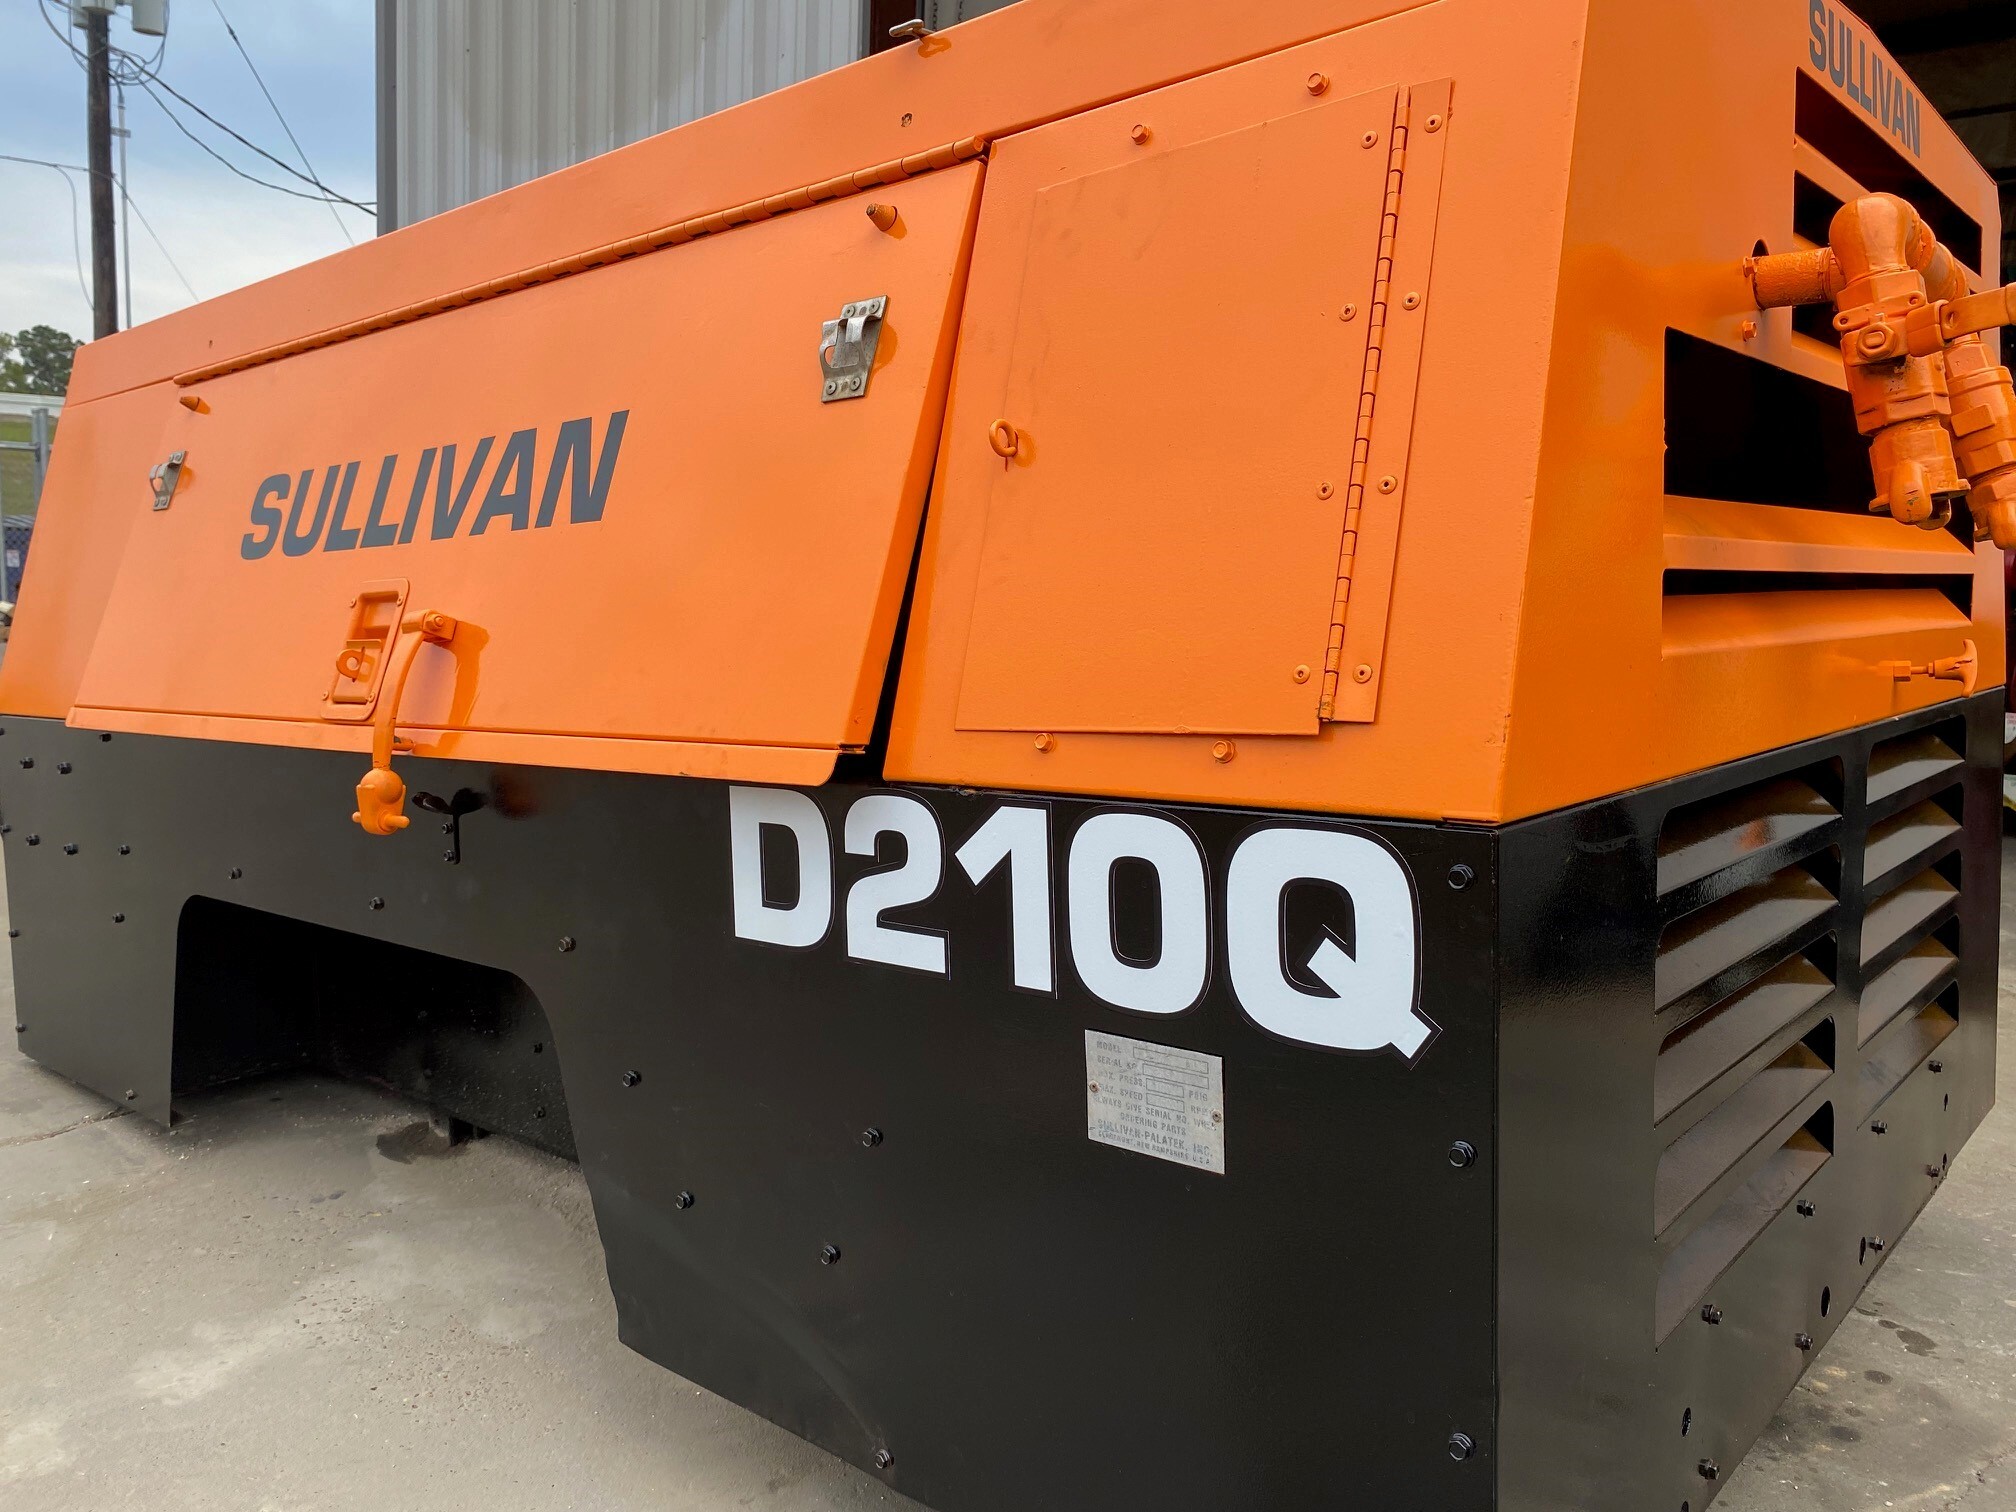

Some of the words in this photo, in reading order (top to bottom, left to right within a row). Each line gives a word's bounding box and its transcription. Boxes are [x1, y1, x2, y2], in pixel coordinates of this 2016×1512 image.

[1809, 0, 1920, 159] SULLIVAN
[241, 410, 629, 560] SULLIVAN
[729, 785, 1436, 1060] D210Q
[1096, 1041, 1122, 1054] MODEL
[1097, 1055, 1123, 1068] SERIAL
[1098, 1070, 1116, 1081] AX.
[1120, 1089, 1143, 1101] SPEED
[1126, 1103, 1142, 1114] GIVE
[1145, 1106, 1172, 1121] SERIAL
[1120, 1112, 1158, 1129] ORDERING
[1161, 1122, 1187, 1136] PARTS
[1193, 1143, 1213, 1158] INC.
